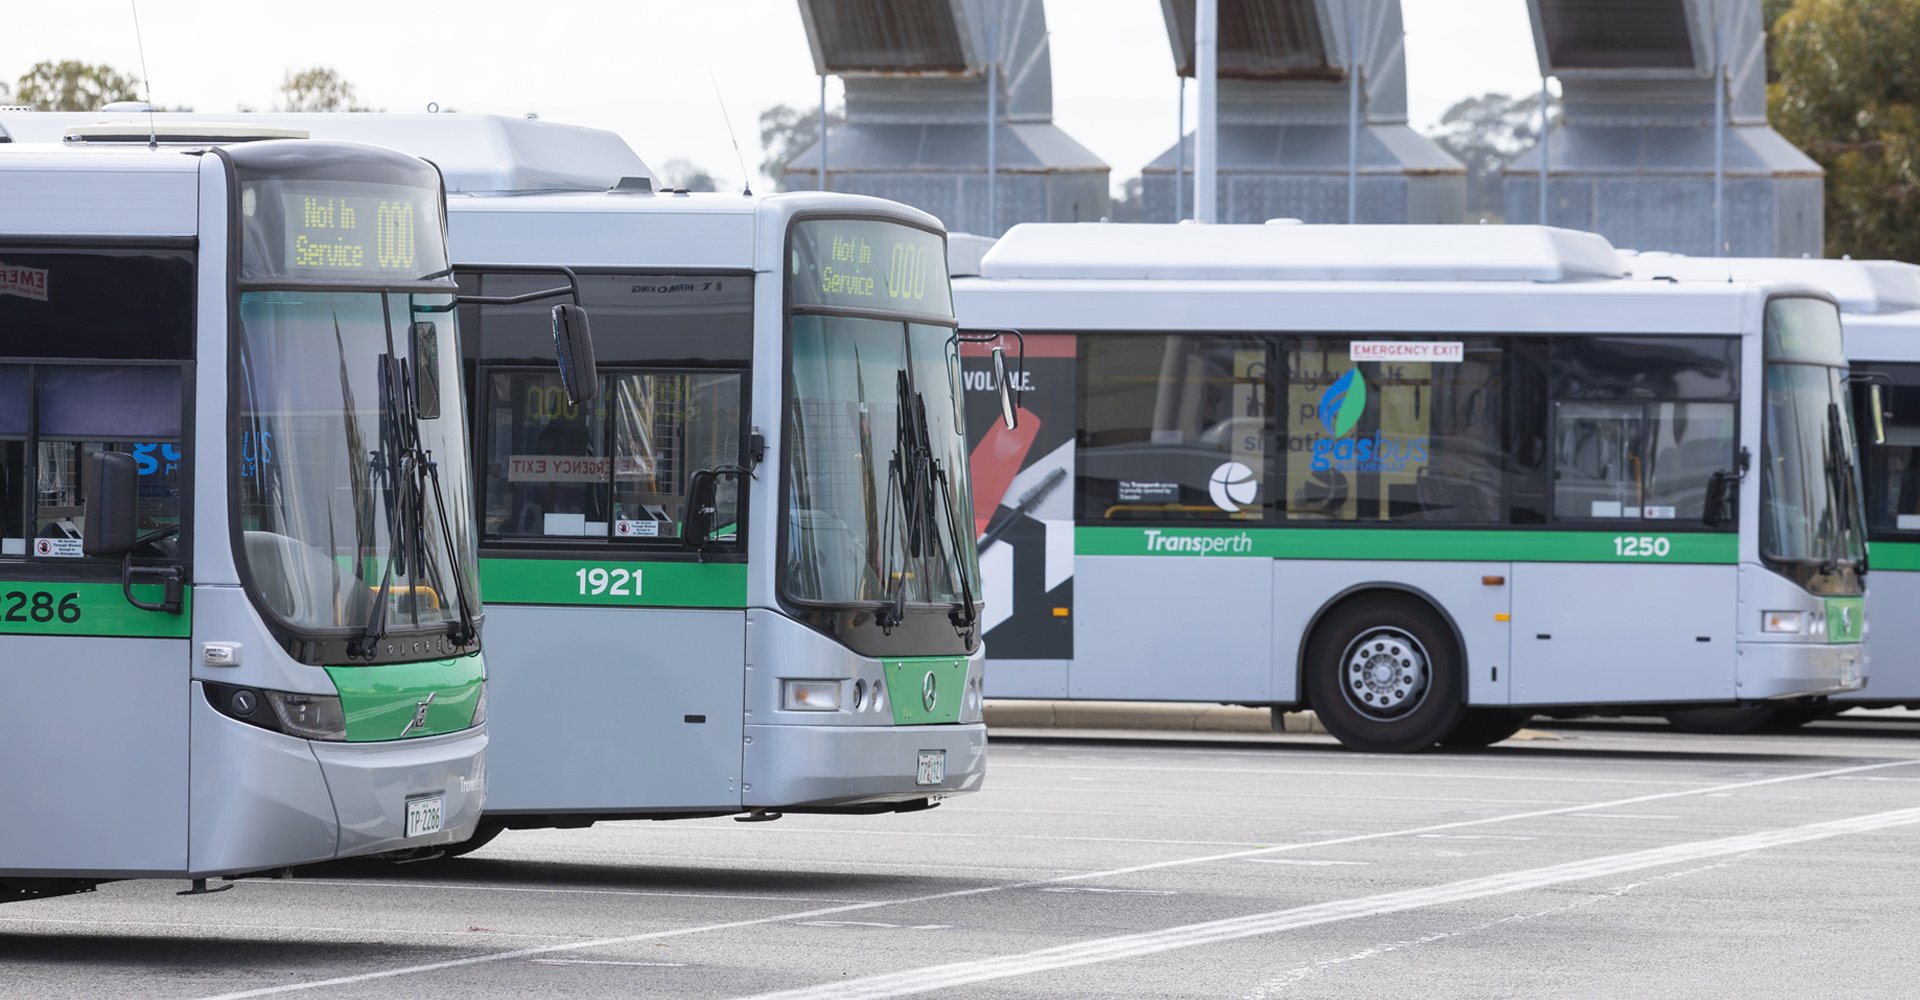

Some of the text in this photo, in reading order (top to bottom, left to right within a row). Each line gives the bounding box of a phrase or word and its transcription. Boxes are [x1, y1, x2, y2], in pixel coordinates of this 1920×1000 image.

[304, 197, 356, 229] Not In
[377, 201, 415, 269] 000
[832, 234, 857, 262] Not
[295, 234, 364, 267] Service
[822, 266, 874, 296] Service
[889, 242, 929, 300] 000
[1353, 346, 1460, 356] EMERGENCY EXIT
[963, 371, 1036, 391] VOLME.
[1311, 430, 1429, 472] gasbus
[1144, 529, 1253, 557] Transperth
[1613, 536, 1670, 557] 1250
[576, 567, 643, 596] 1921
[0, 590, 81, 624] 286
